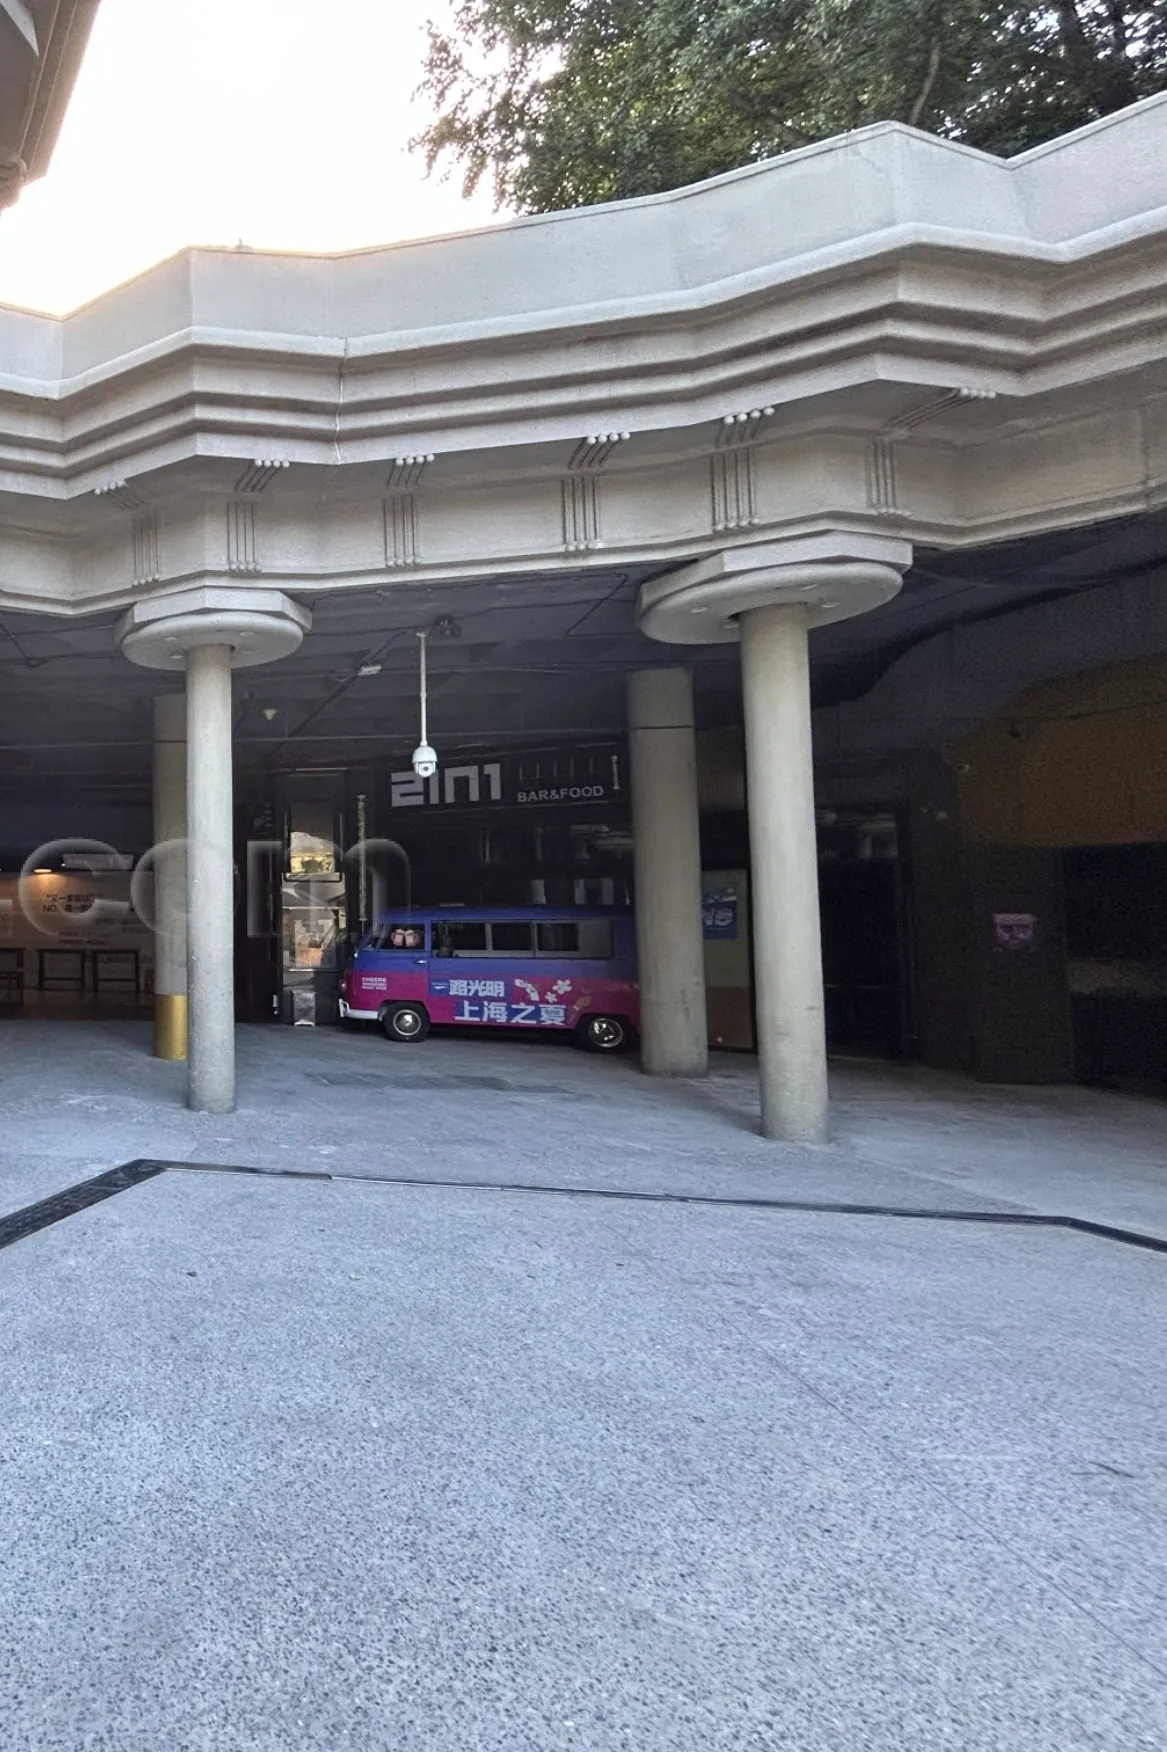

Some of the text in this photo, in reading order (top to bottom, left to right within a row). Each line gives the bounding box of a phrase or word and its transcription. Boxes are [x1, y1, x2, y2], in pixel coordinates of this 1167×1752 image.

[517, 785, 604, 803] BAR&FOOD
[454, 1000, 567, 1026] 上海之夏
